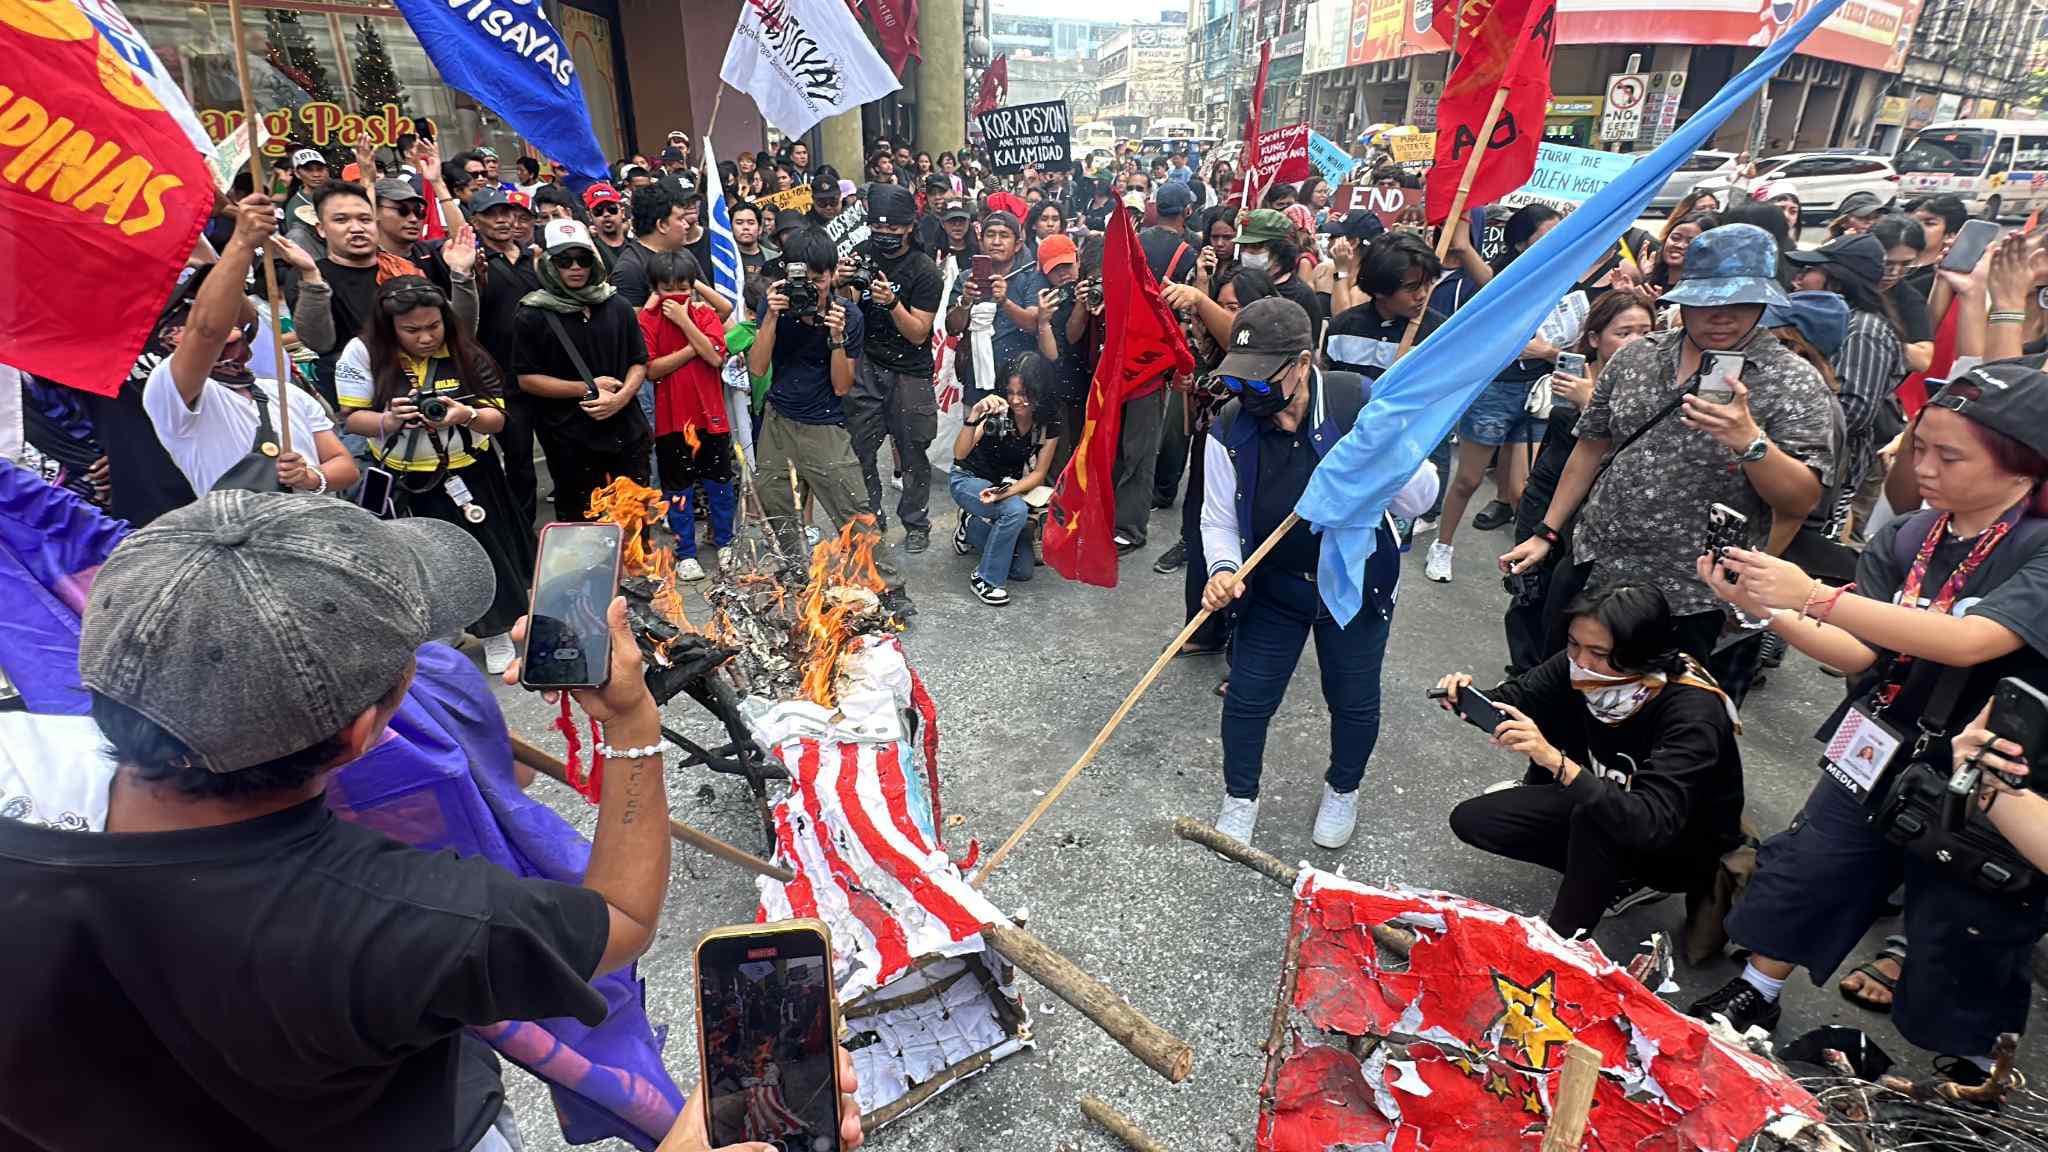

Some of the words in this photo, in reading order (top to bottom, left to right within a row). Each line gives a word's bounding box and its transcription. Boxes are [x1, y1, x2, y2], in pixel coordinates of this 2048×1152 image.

[448, 0, 574, 86] ISAYAS
[301, 102, 438, 148] Pask
[982, 104, 1067, 140] KORAPSYON
[1607, 122, 1635, 131] LEFT
[1612, 110, 1633, 122] NO
[1605, 131, 1634, 139] TURN
[0, 84, 185, 236] PINAS
[993, 145, 1064, 167] KALAMIDAD
[1536, 149, 1572, 166] TURN
[1580, 155, 1602, 169] THE
[1531, 167, 1571, 192] OLEN
[1349, 185, 1405, 213] END
[1825, 762, 1858, 794] MEDIA
